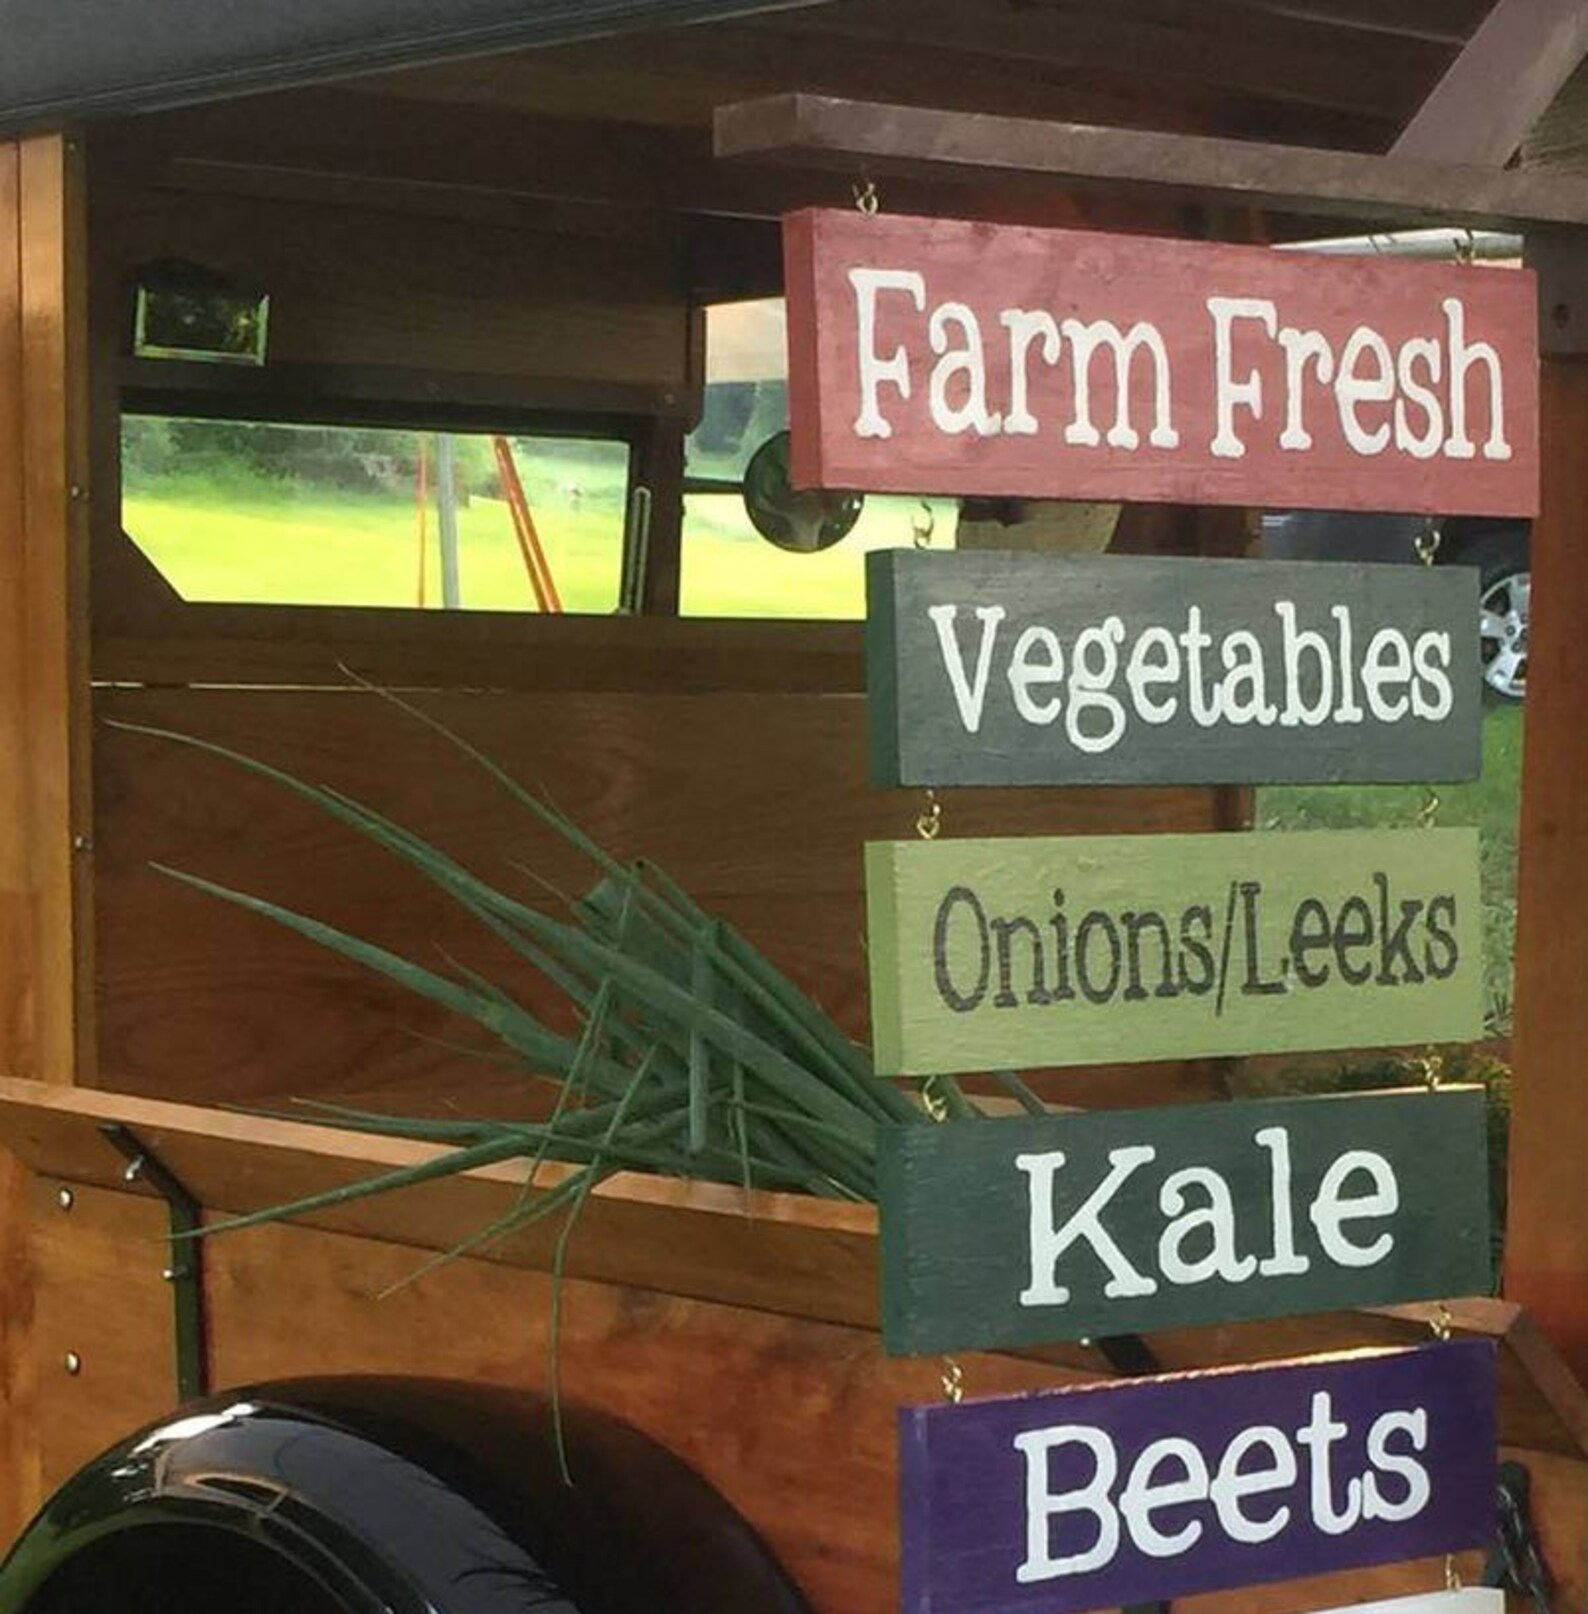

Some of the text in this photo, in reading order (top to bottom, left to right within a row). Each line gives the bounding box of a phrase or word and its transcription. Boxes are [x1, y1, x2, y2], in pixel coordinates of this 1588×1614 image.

[847, 267, 1513, 460] Farm Fresh
[927, 600, 1454, 754] Vegetables
[933, 872, 1461, 1018] Onions/Leeks
[1014, 1126, 1400, 1308] Kale
[1013, 1390, 1431, 1584] Beets
